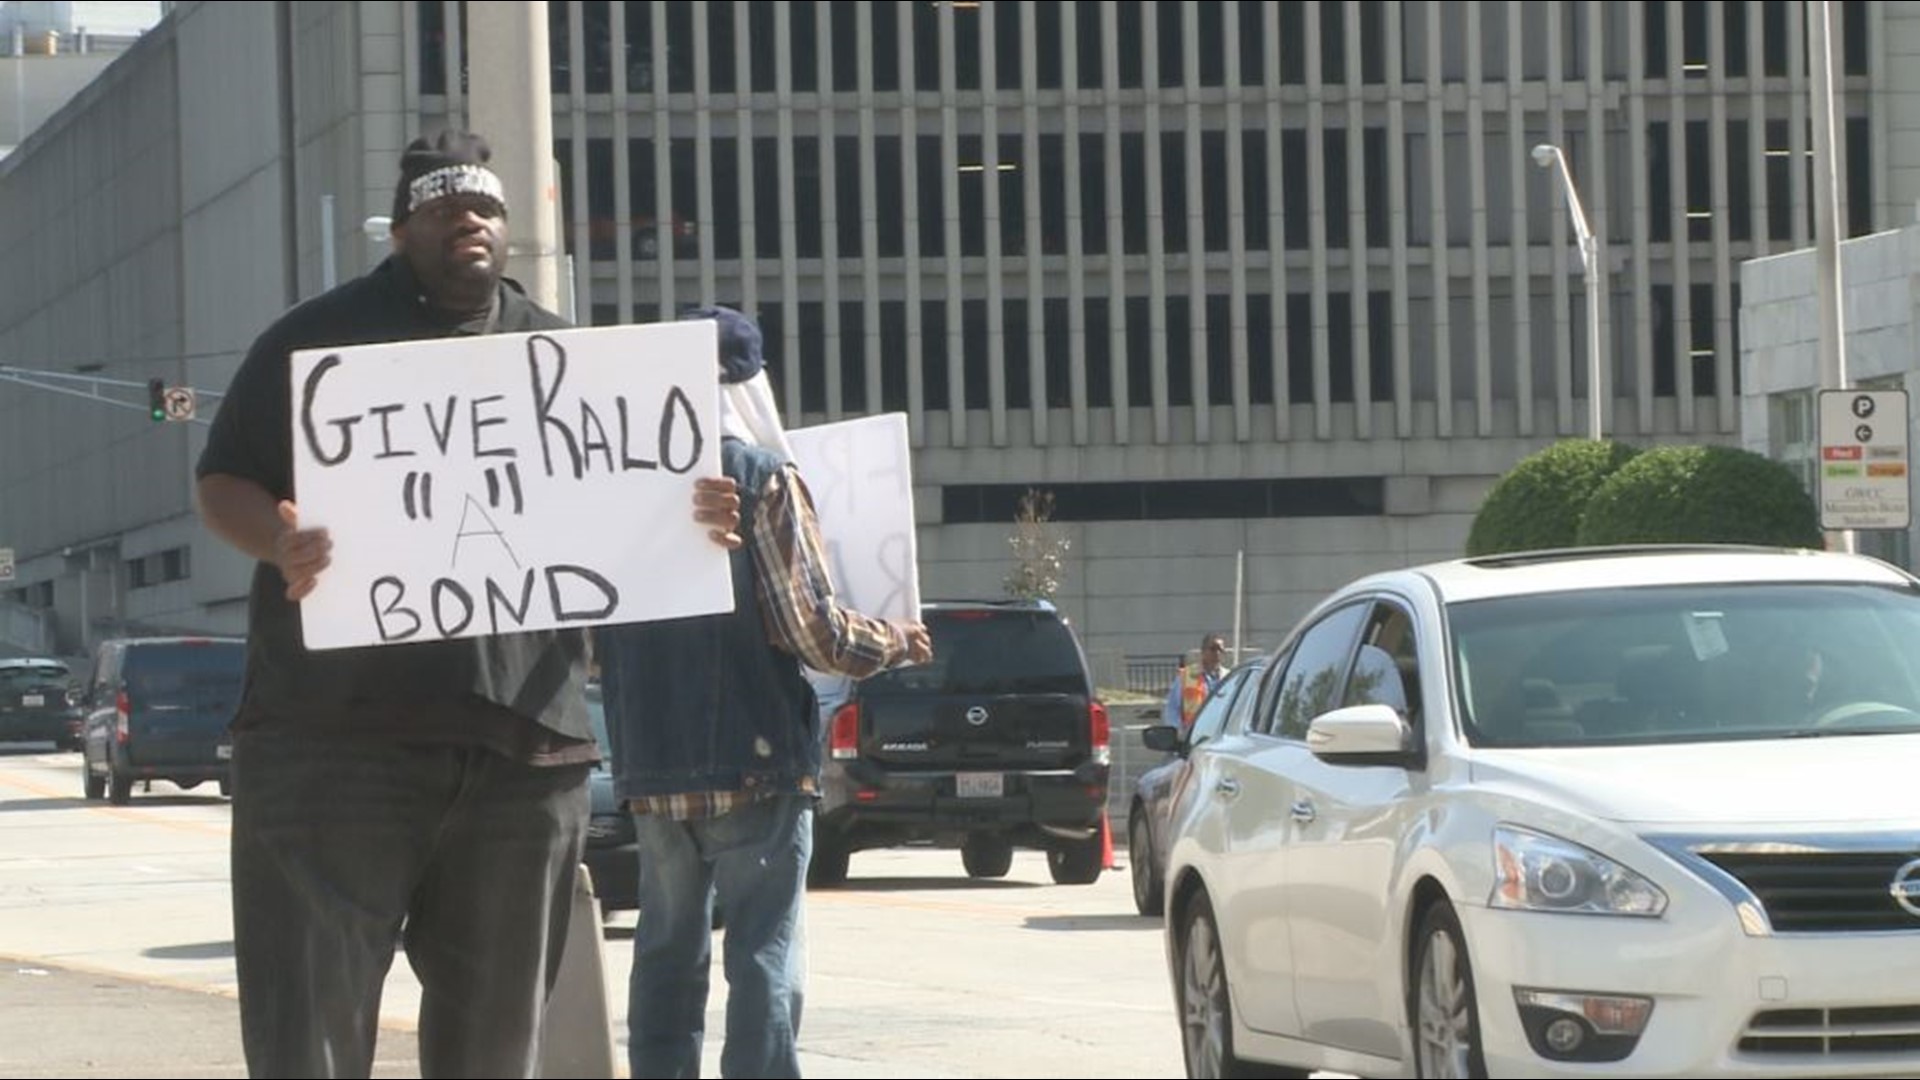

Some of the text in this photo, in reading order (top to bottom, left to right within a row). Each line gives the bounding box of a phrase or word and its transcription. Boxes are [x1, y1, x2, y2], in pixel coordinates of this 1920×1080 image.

[301, 334, 703, 478] GIVE RALO
[370, 565, 619, 641] BOND
